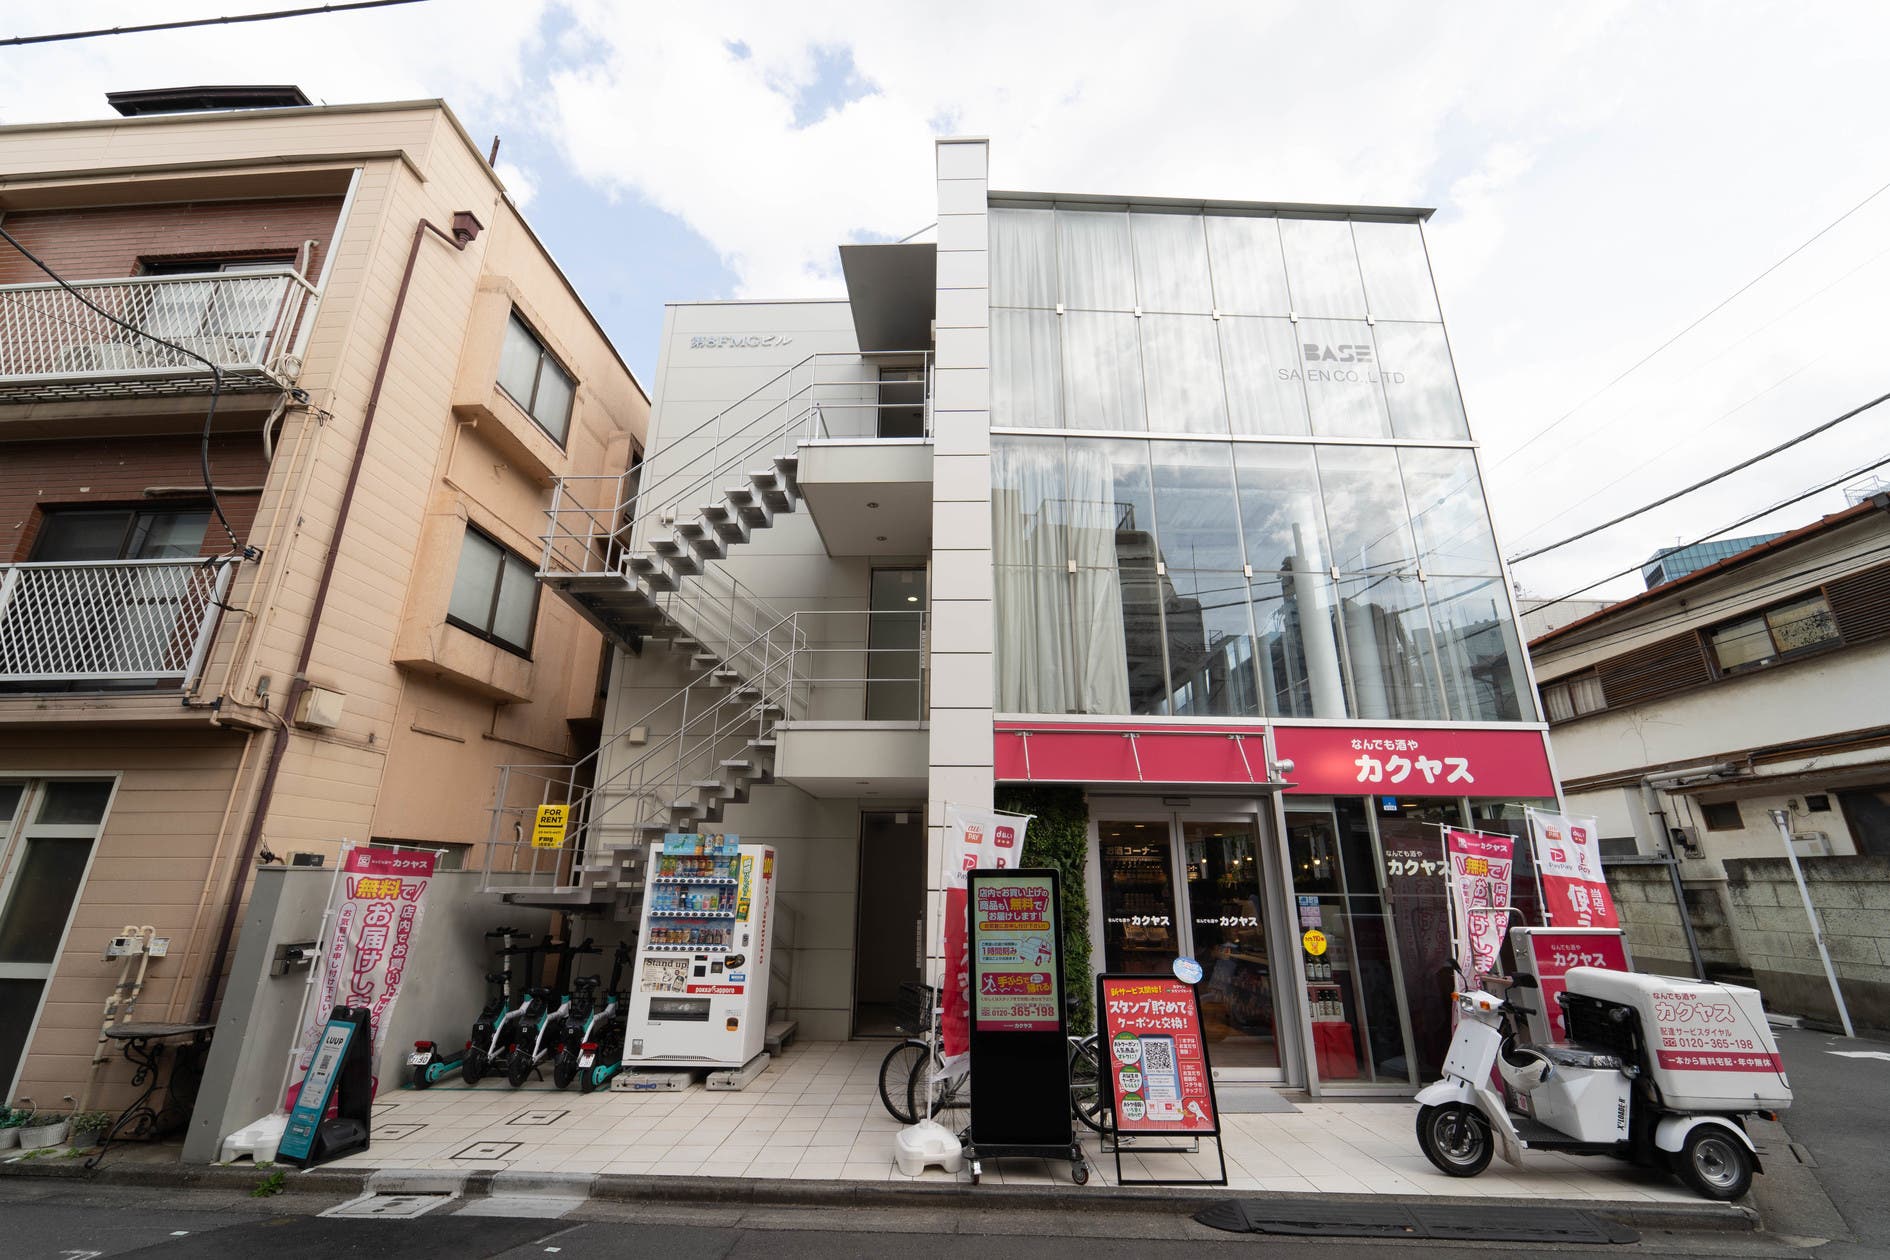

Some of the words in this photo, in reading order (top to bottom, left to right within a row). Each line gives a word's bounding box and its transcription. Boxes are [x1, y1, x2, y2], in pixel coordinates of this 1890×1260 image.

[1303, 343, 1373, 363] BASE
[1278, 368, 1331, 382] SAEN
[1351, 738, 1418, 751] なんでも酒や
[1354, 754, 1475, 784] カクヤス
[1386, 850, 1424, 858] なんでも酒や
[392, 858, 428, 869] カクヤス
[1387, 859, 1452, 877] カクヤス
[356, 876, 415, 900] 無料で
[978, 887, 1048, 898] 店内でお買い上げの
[1010, 898, 1043, 911] 無料で
[1590, 888, 1607, 916] 当店で
[988, 911, 1042, 921] お届けします!
[1131, 916, 1170, 926] カクヤス
[1219, 916, 1258, 926] カクヤス
[645, 959, 673, 968] Stand
[1553, 952, 1607, 967] カクヤス
[998, 975, 1030, 988] 手ぶらで
[1652, 992, 1697, 1001] なんでも酒や
[991, 1006, 1055, 1017] 0120-365-198
[1109, 999, 1187, 1015] スタンプ貯めて
[1655, 1001, 1736, 1023] カクヤス
[1117, 1018, 1188, 1029] クーポンと交換!
[325, 1036, 344, 1045] LUUP
[1679, 1038, 1754, 1050] 0120-365-198
